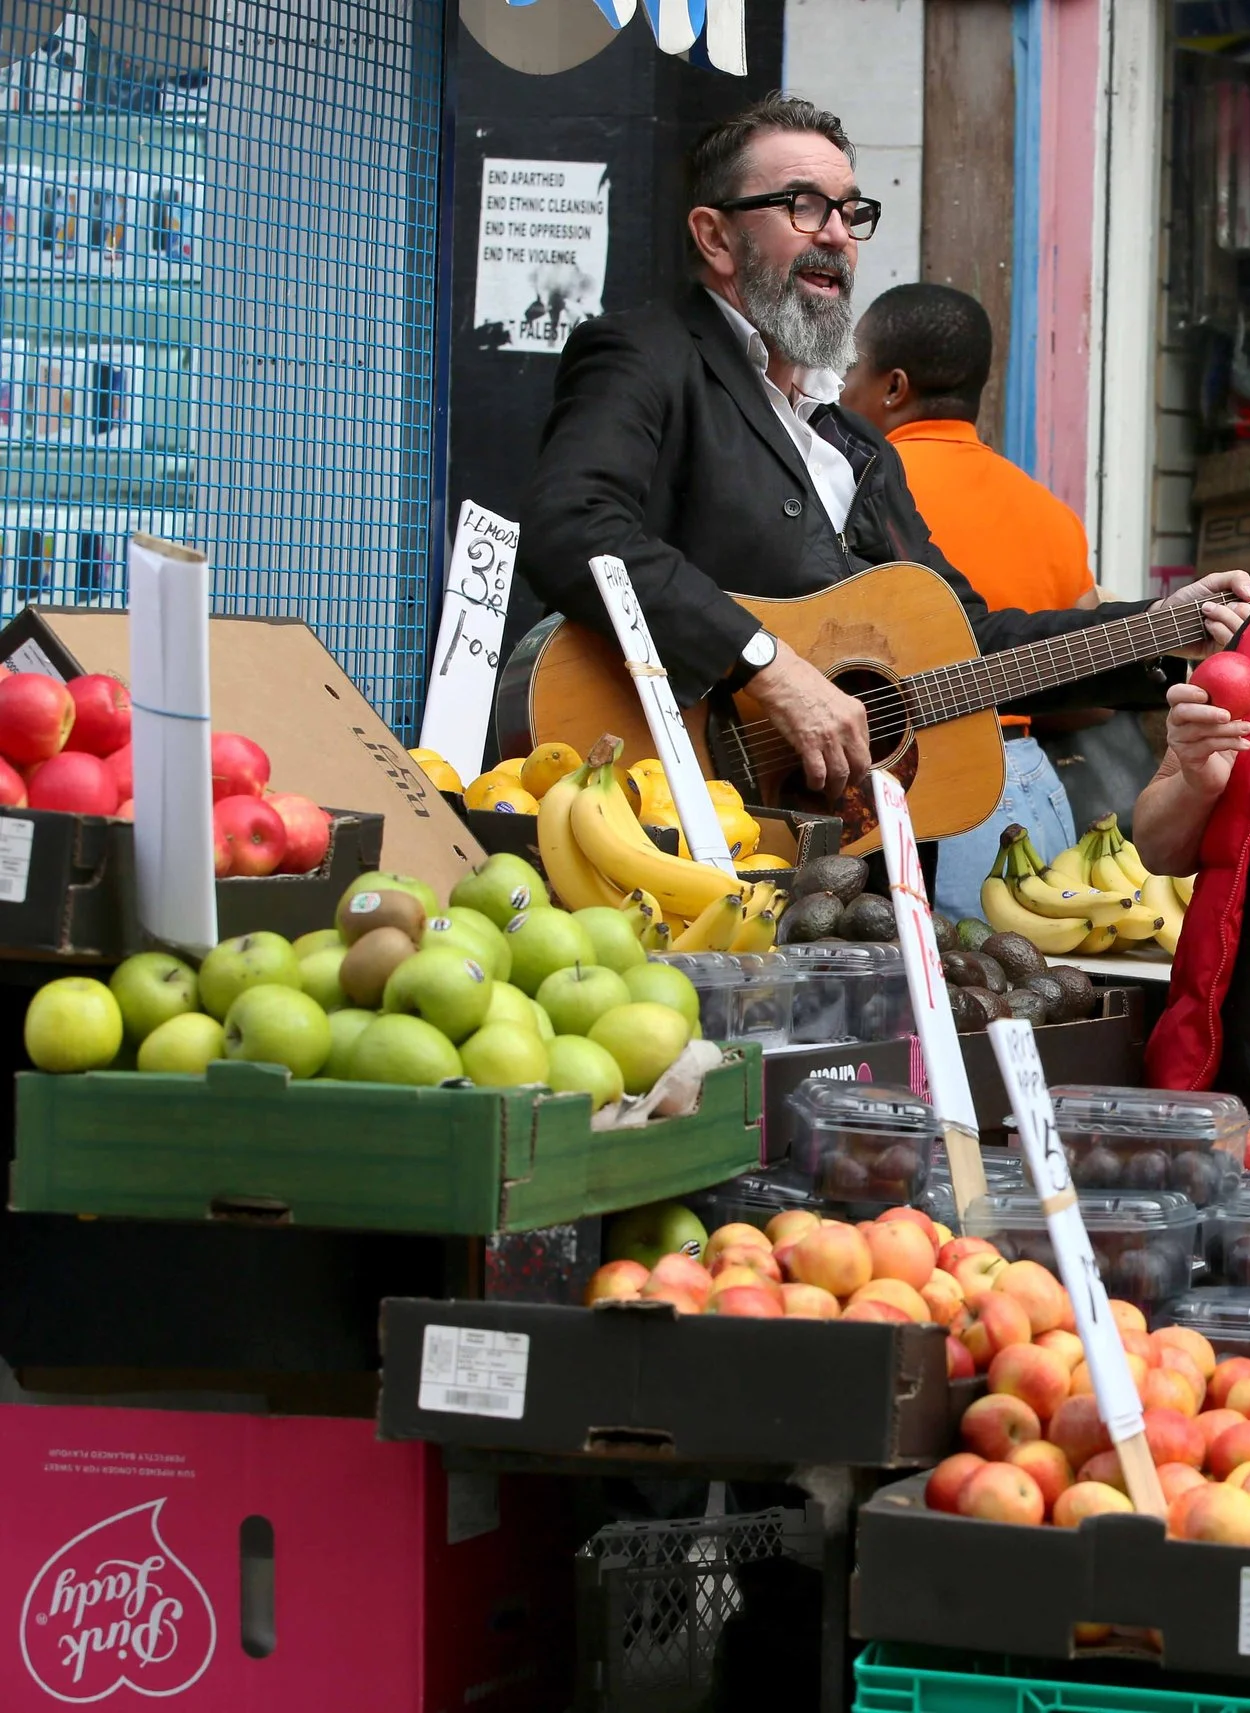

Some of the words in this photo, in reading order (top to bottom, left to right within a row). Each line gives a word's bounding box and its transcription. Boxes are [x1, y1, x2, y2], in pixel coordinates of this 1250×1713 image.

[488, 170, 508, 186] END
[511, 172, 565, 187] APARTHEID
[487, 196, 506, 211] END
[509, 197, 545, 213] ETHNIC
[547, 199, 604, 215] CLEANSING
[485, 221, 505, 237] END
[508, 223, 526, 237] THE
[529, 224, 592, 241] OPPRESSION
[483, 247, 502, 262] END
[506, 248, 524, 264] THE
[528, 249, 577, 266] VIOLENCE
[463, 508, 519, 549] LEMONS
[461, 538, 495, 606] 3
[49, 1555, 165, 1628] Lady
[58, 1597, 184, 1683] Pink
